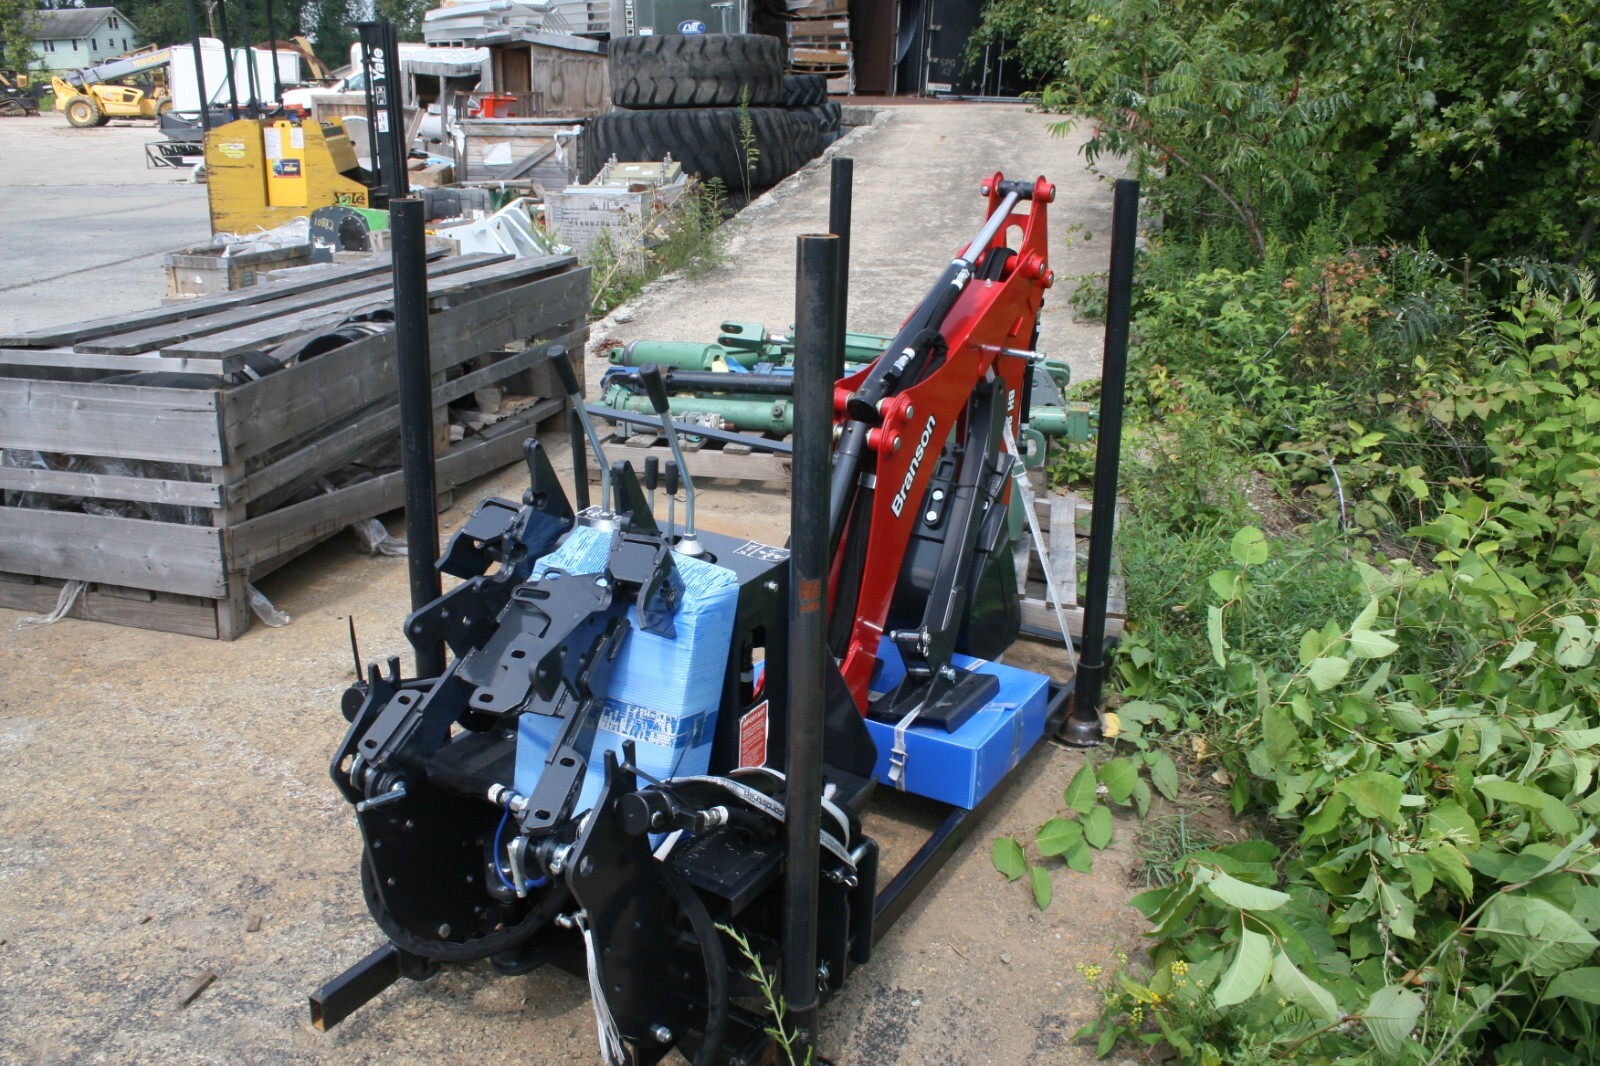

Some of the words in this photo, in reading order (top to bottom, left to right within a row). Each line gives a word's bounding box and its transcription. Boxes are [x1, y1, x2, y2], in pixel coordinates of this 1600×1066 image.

[371, 48, 386, 81] Yale
[939, 58, 956, 67] SPG
[1007, 389, 1015, 412] BH
[891, 414, 936, 518] Branson
[743, 708, 766, 727] IMPORTANT
